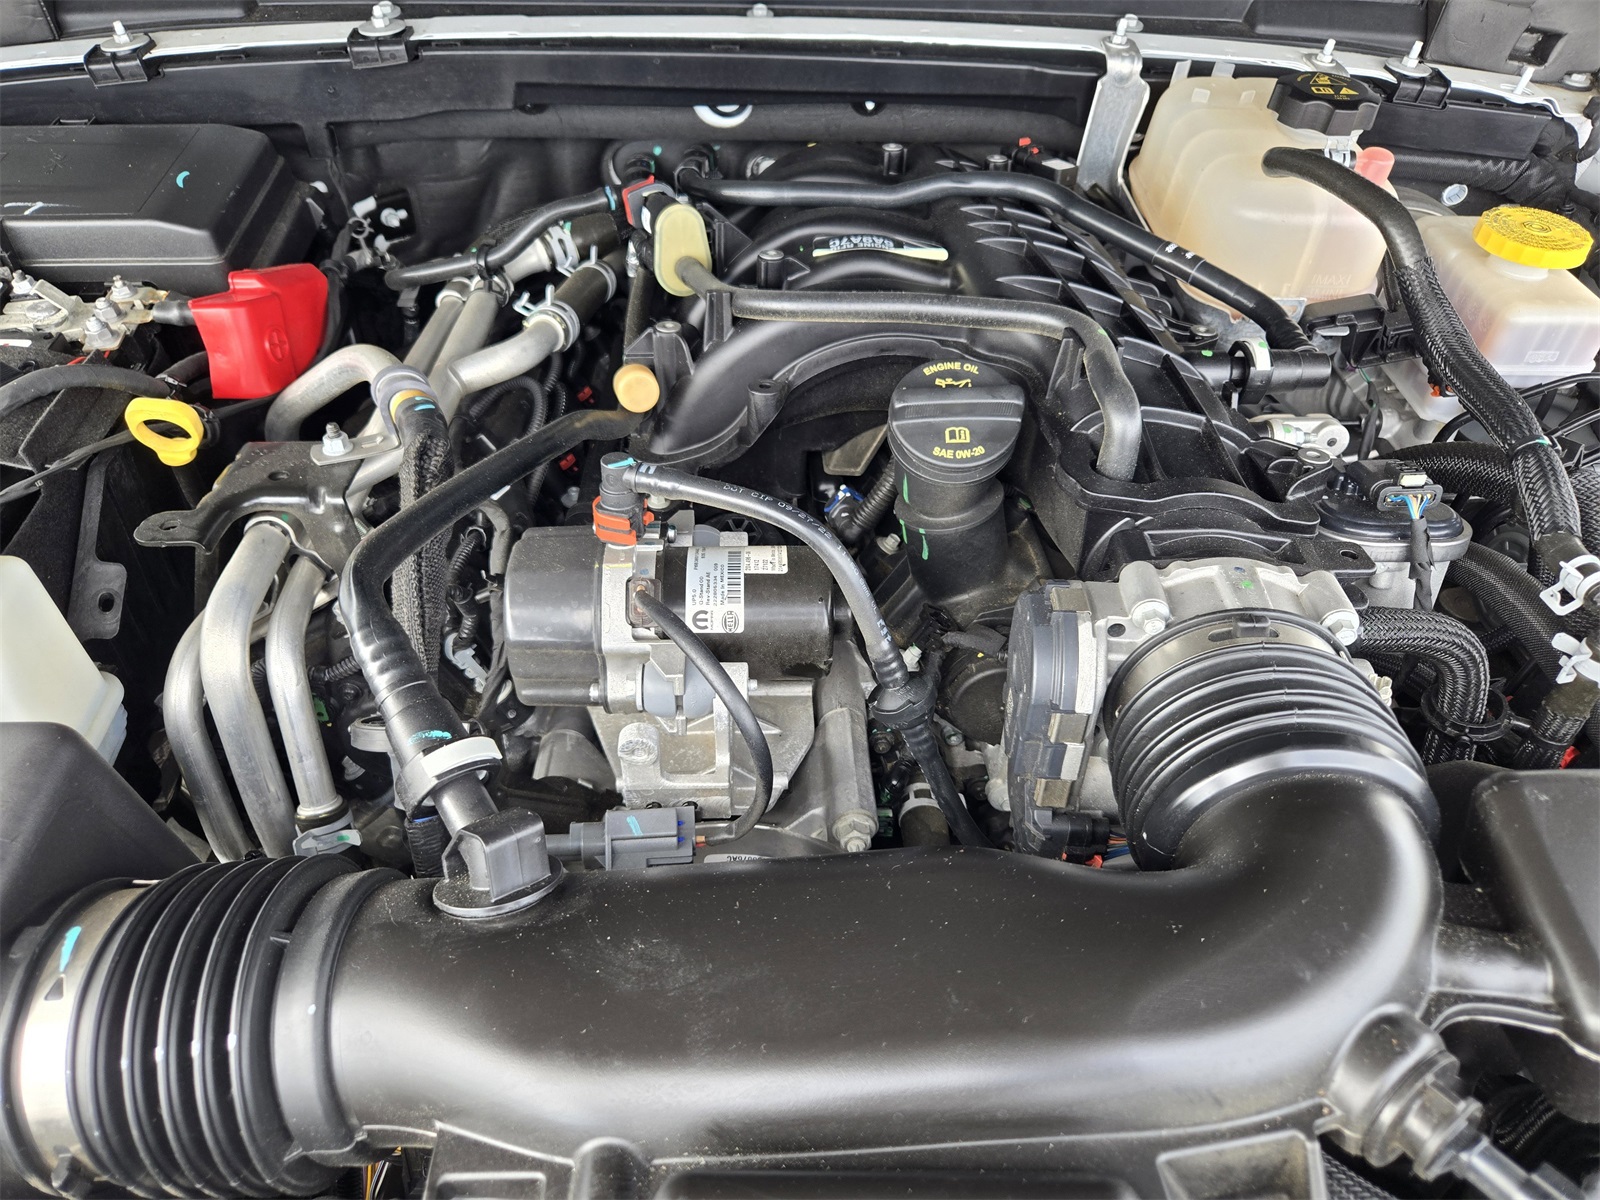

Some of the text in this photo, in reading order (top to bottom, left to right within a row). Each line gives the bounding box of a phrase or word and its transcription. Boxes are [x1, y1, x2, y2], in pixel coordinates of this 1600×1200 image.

[923, 362, 979, 376] ENGINE OIL
[932, 445, 985, 459] SAE 0W-20
[726, 610, 734, 632] HELLA
